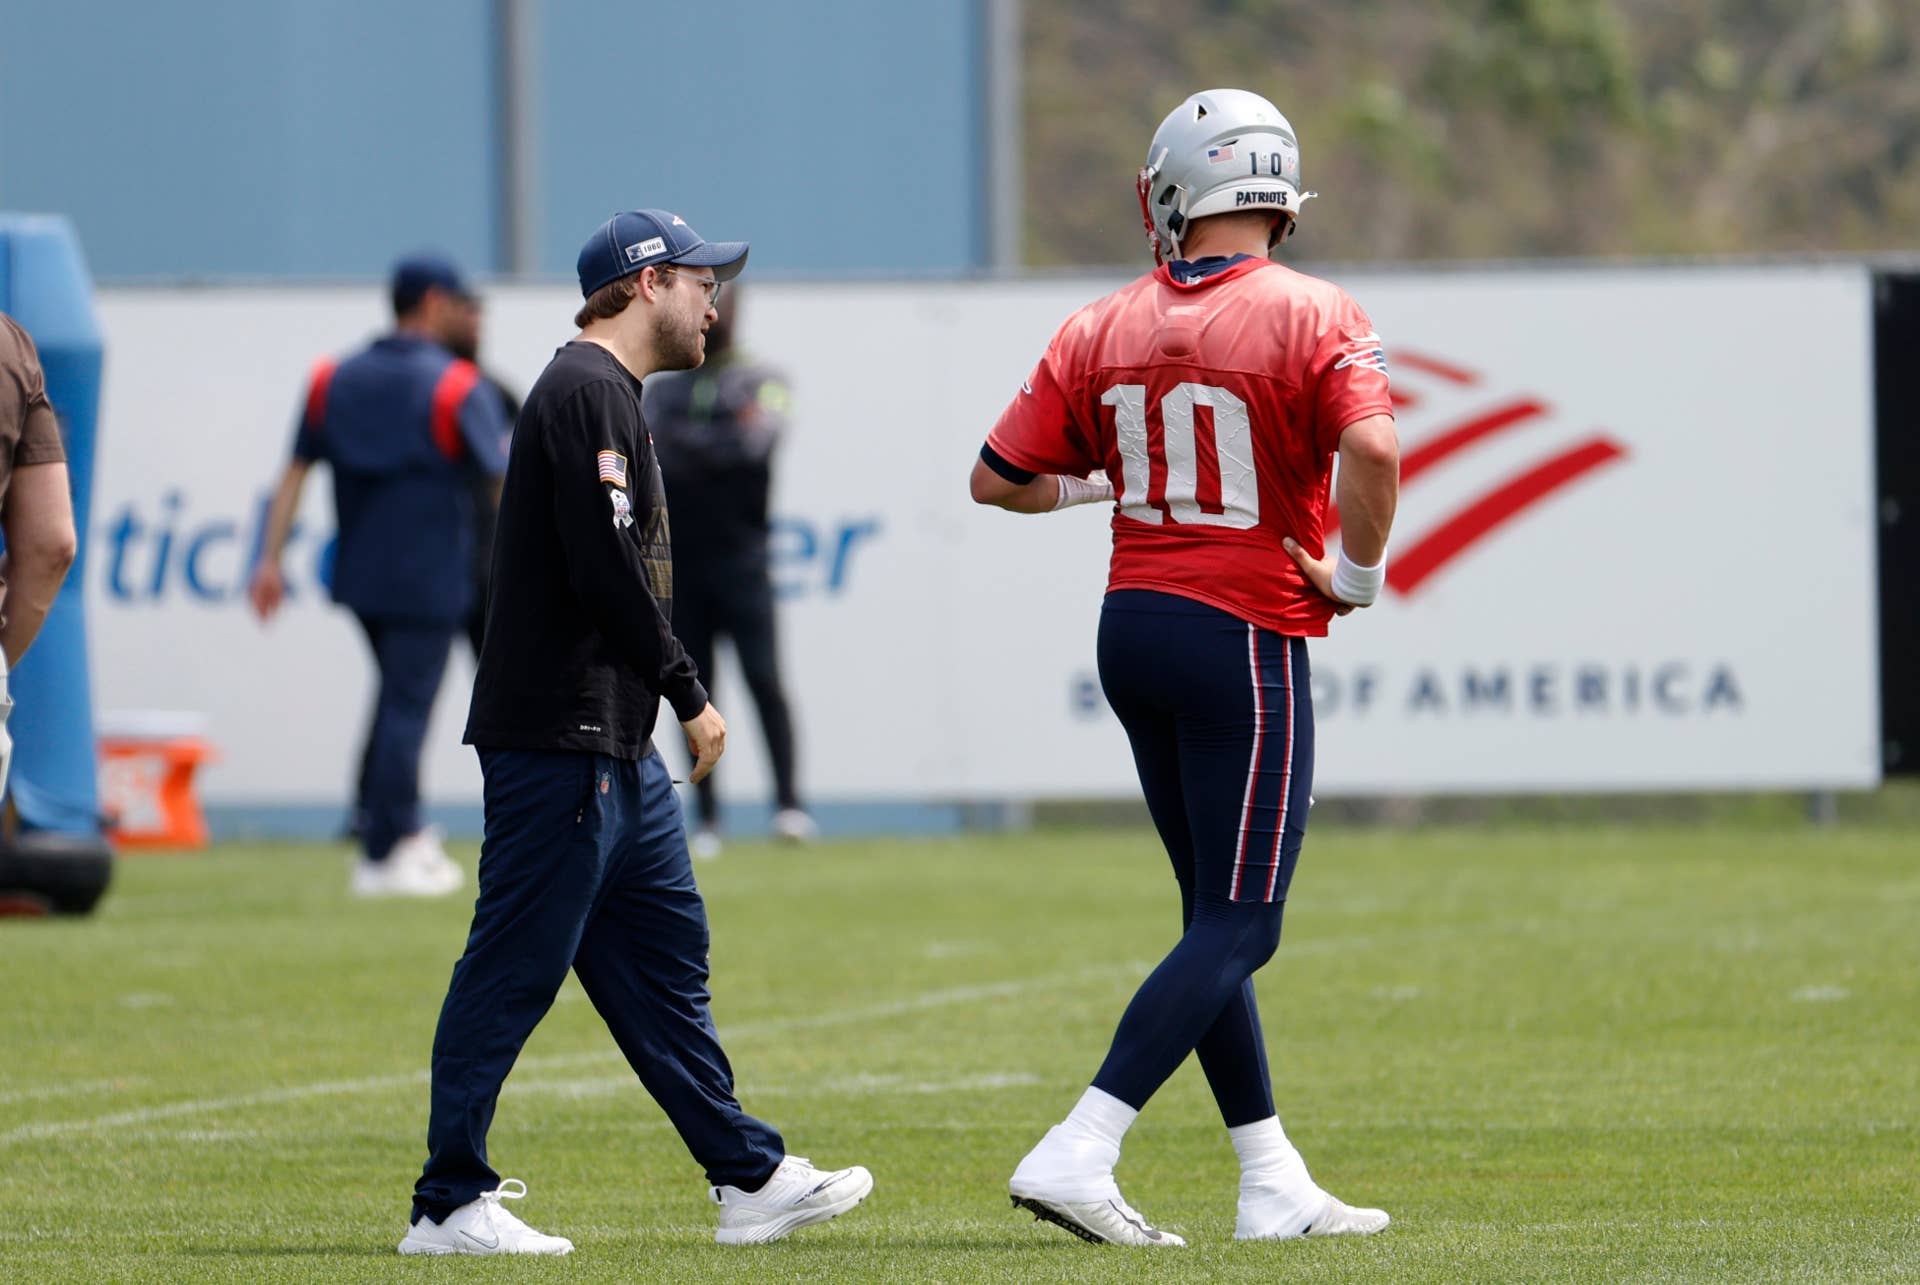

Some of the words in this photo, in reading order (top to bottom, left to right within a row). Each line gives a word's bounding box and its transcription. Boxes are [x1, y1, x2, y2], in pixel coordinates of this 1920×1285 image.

[1250, 152, 1282, 175] 10
[1236, 191, 1287, 206] PATRIOTS
[1101, 382, 1259, 530] 10
[1405, 665, 1746, 716] AMERICA
